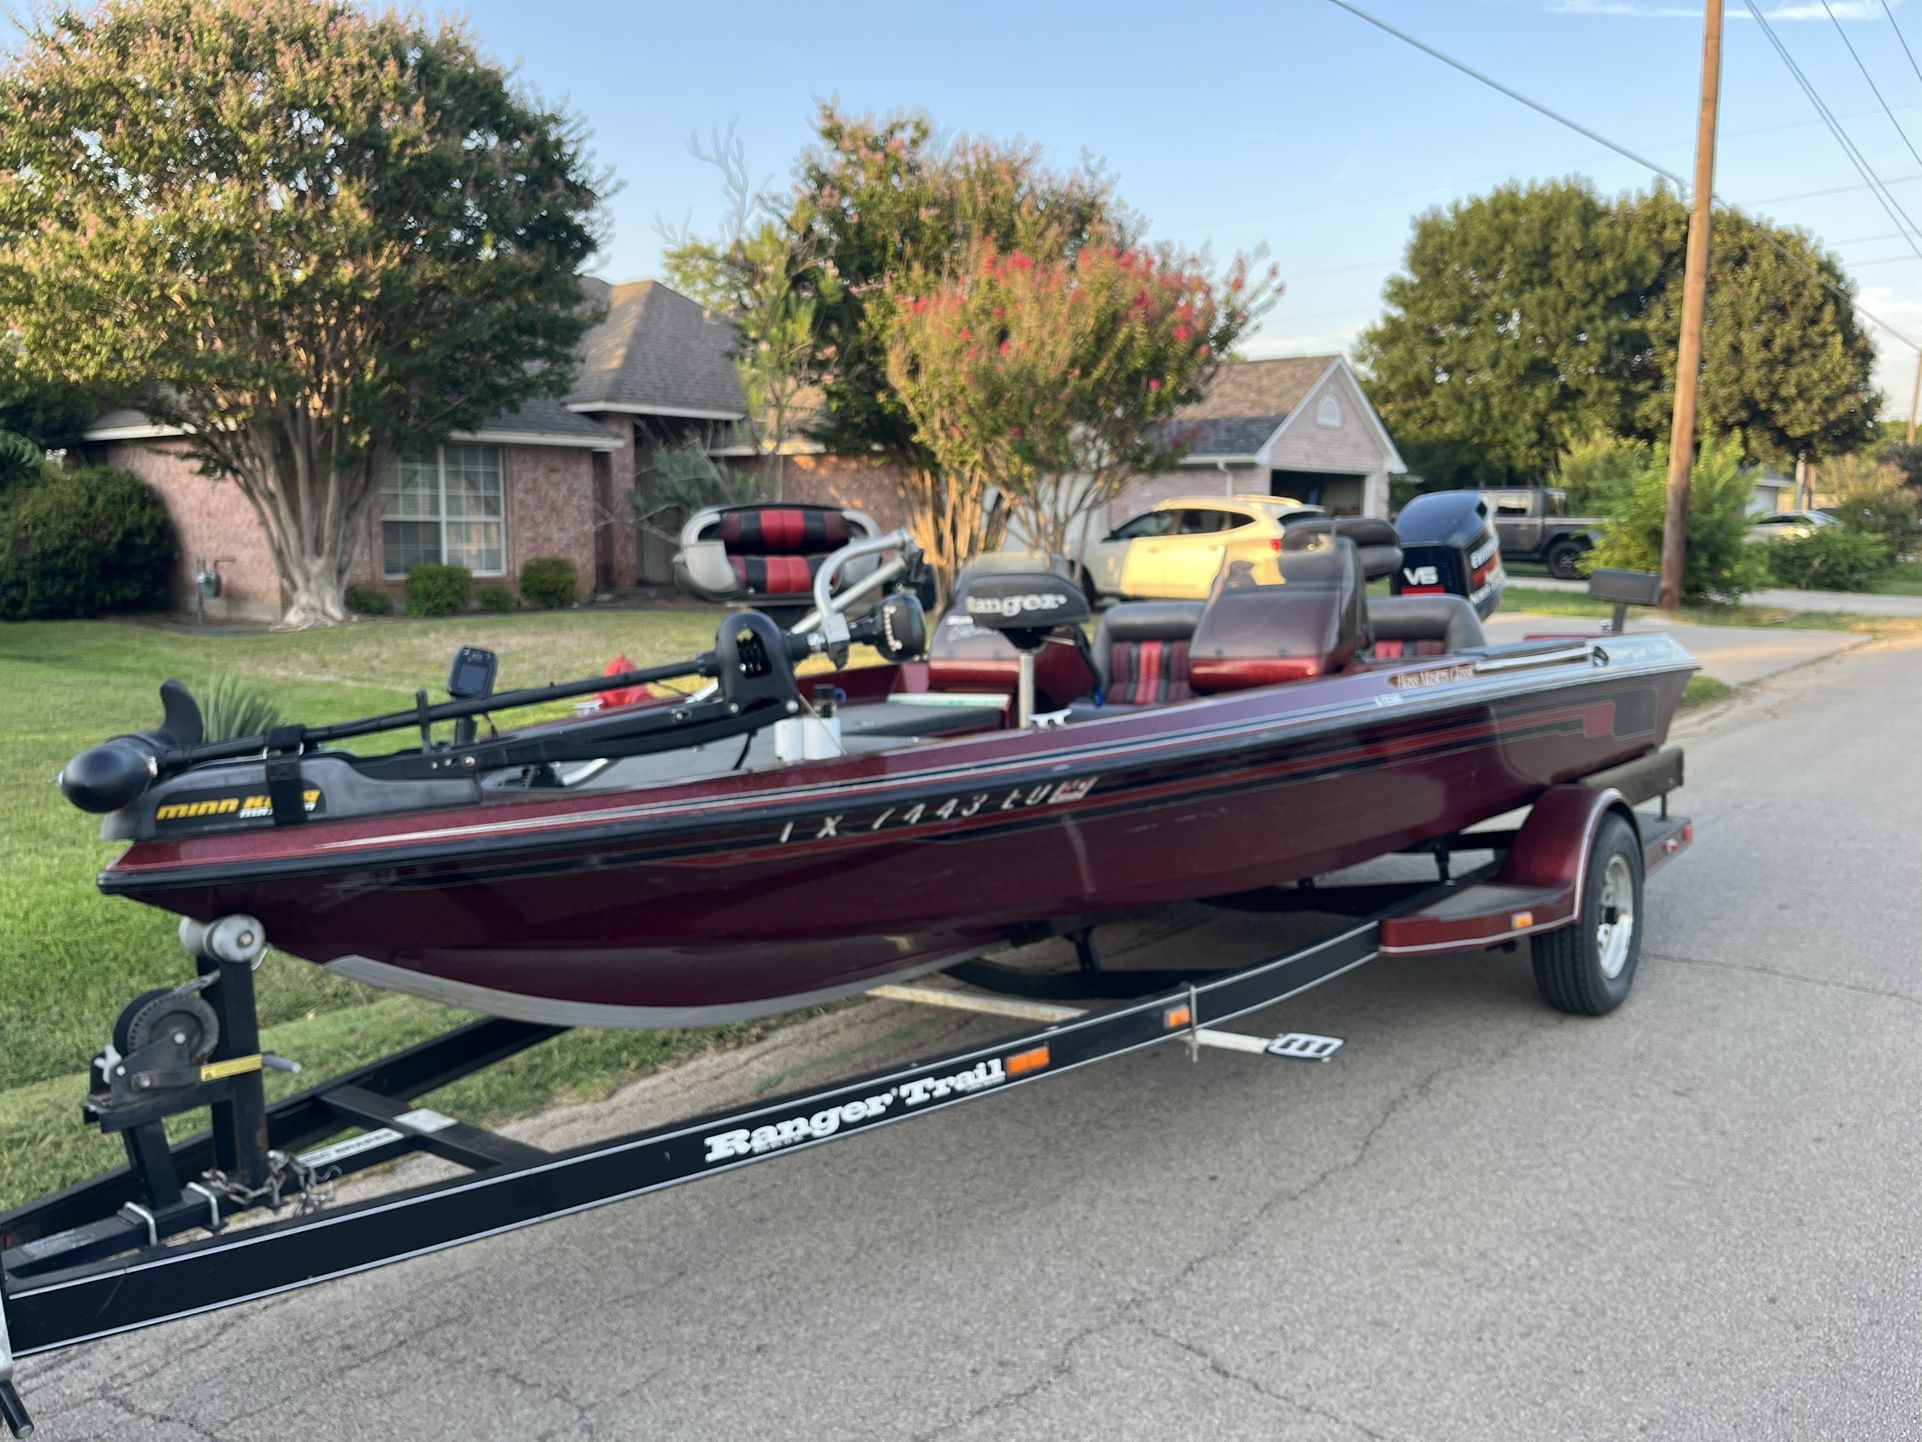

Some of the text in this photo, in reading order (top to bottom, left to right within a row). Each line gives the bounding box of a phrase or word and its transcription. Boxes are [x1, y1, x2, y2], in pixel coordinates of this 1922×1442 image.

[1403, 566, 1438, 585] V6
[704, 1057, 1006, 1163] Ranger Trail
